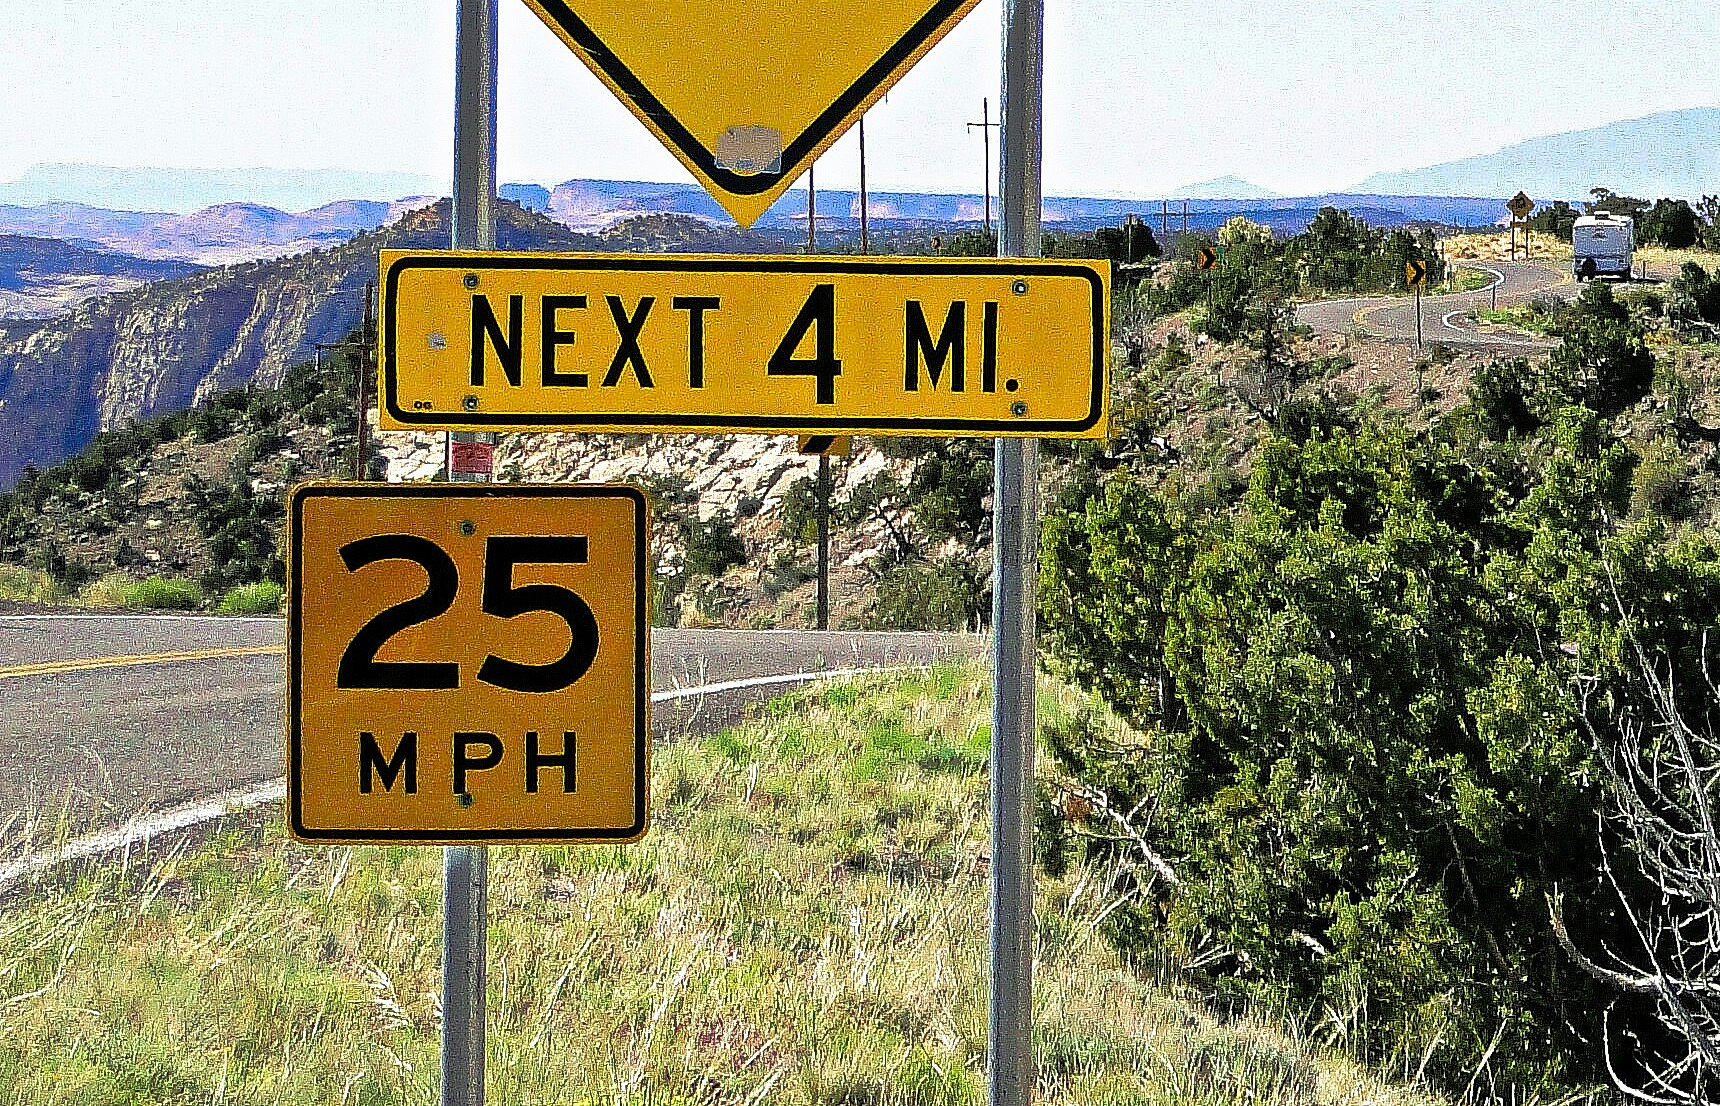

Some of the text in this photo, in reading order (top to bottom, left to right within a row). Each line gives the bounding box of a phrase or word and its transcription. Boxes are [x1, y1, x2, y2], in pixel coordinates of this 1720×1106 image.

[471, 284, 1021, 404] NEXT 4 MI.
[336, 535, 599, 693] 25
[358, 731, 576, 794] MPH
